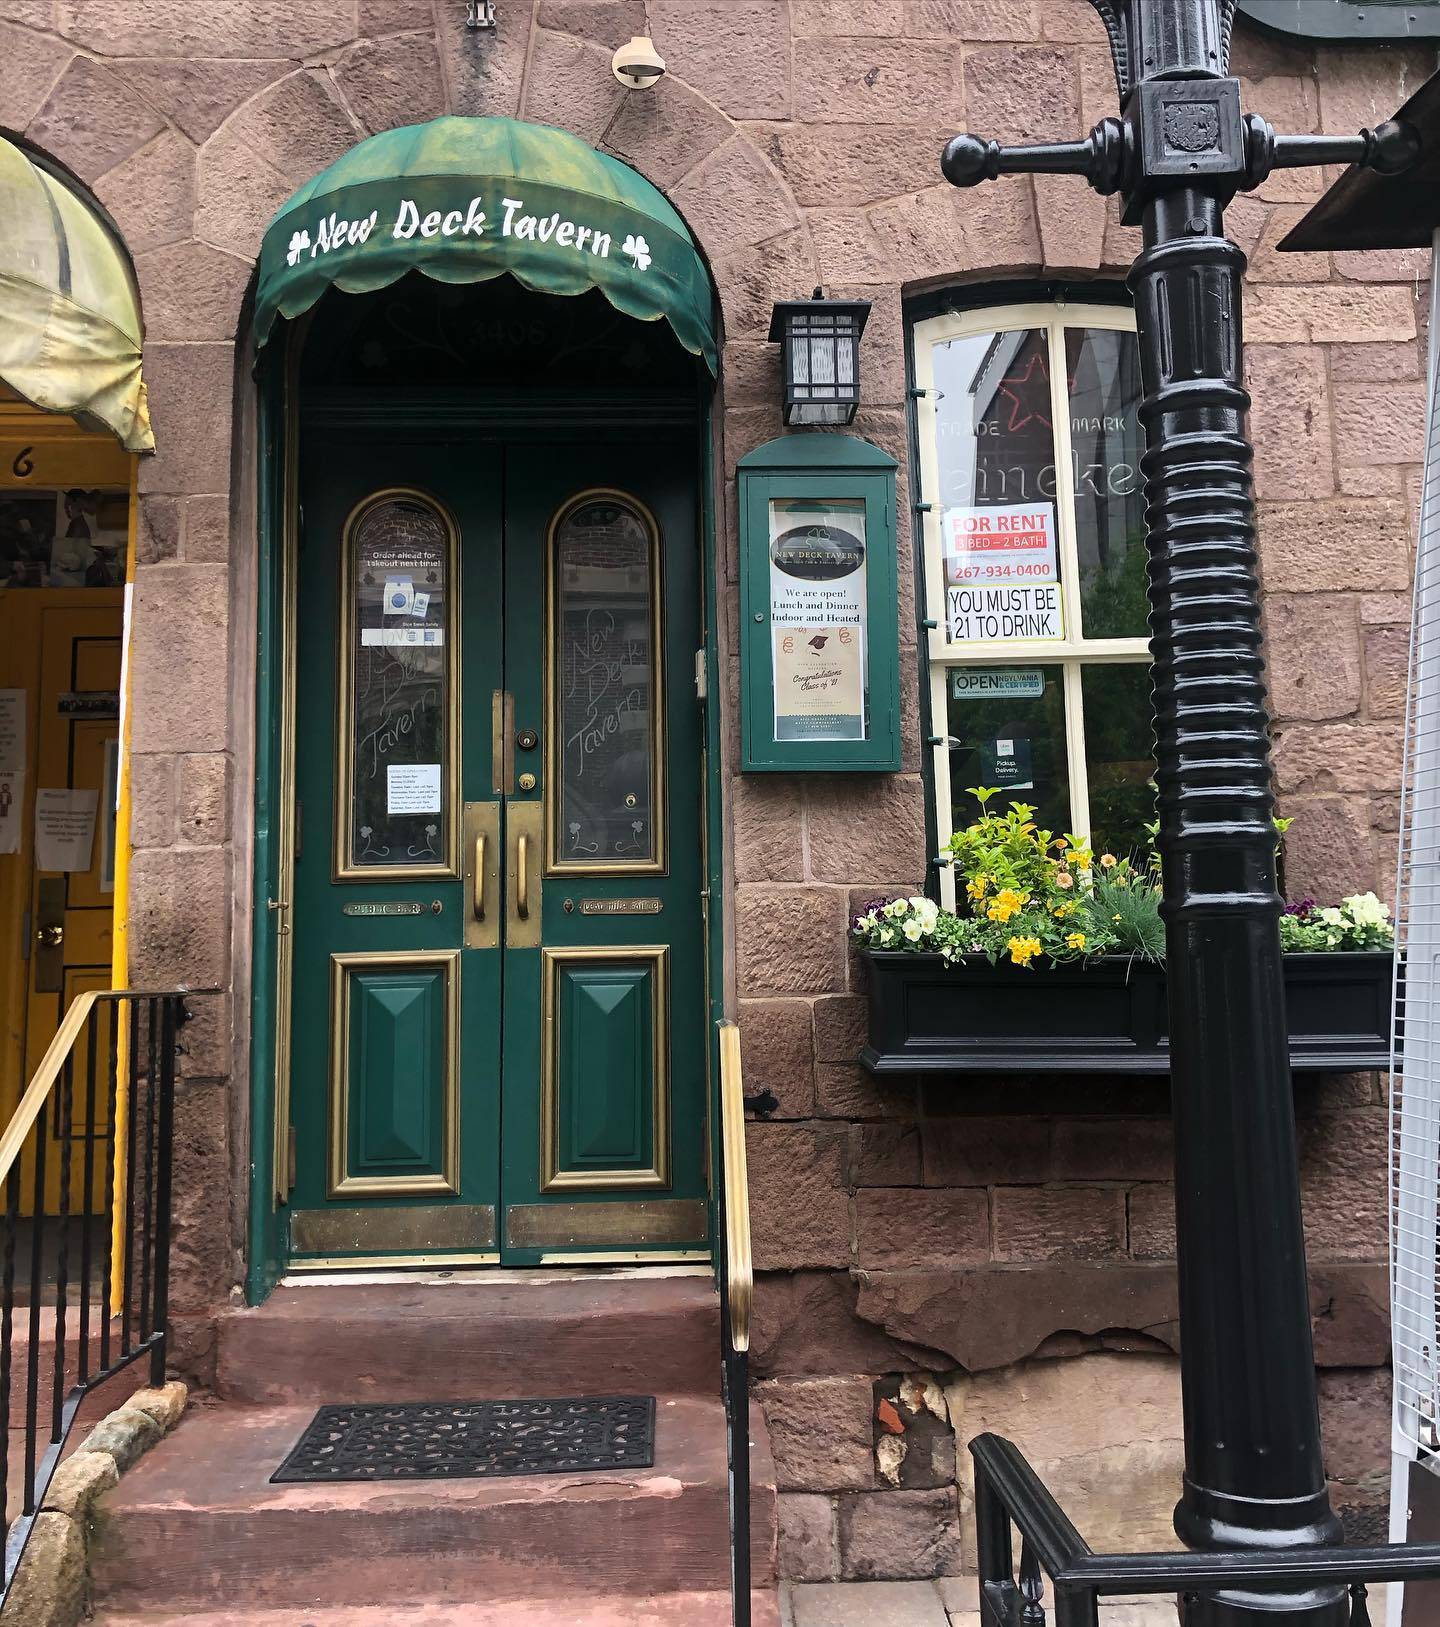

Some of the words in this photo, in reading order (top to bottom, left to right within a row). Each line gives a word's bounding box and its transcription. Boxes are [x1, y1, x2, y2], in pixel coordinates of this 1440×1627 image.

[311, 210, 378, 258] New
[392, 196, 486, 240] Deck
[502, 198, 611, 258] Tavern
[1072, 417, 1127, 433] MARK
[13, 446, 34, 477] 6
[953, 516, 992, 532] FOR
[998, 514, 1048, 531] RENT
[968, 537, 991, 548] BED
[1004, 537, 1010, 547] 2
[1014, 536, 1044, 546] BATH
[373, 551, 395, 559] Order
[397, 551, 422, 559] ahead
[423, 551, 436, 559] for
[955, 564, 1050, 579] 267-934-0400
[786, 589, 800, 597] We
[820, 589, 846, 599] open!
[950, 590, 983, 613] YOU
[987, 588, 1031, 612] MUST
[1034, 588, 1056, 610] BE
[773, 601, 803, 609] Lunch
[806, 601, 823, 610] and
[826, 602, 859, 610] Dinner
[772, 613, 804, 621] Indoor
[806, 613, 823, 622] and
[827, 614, 860, 622] Heated
[955, 616, 970, 638] 21
[976, 615, 999, 638] TO
[1002, 613, 1055, 637] DRINK.
[793, 669, 842, 683] Congratulations
[957, 676, 998, 689] OPEN
[801, 682, 819, 691] Class
[820, 681, 828, 690] of
[360, 688, 437, 778] Tavern
[567, 688, 642, 777] Tavern
